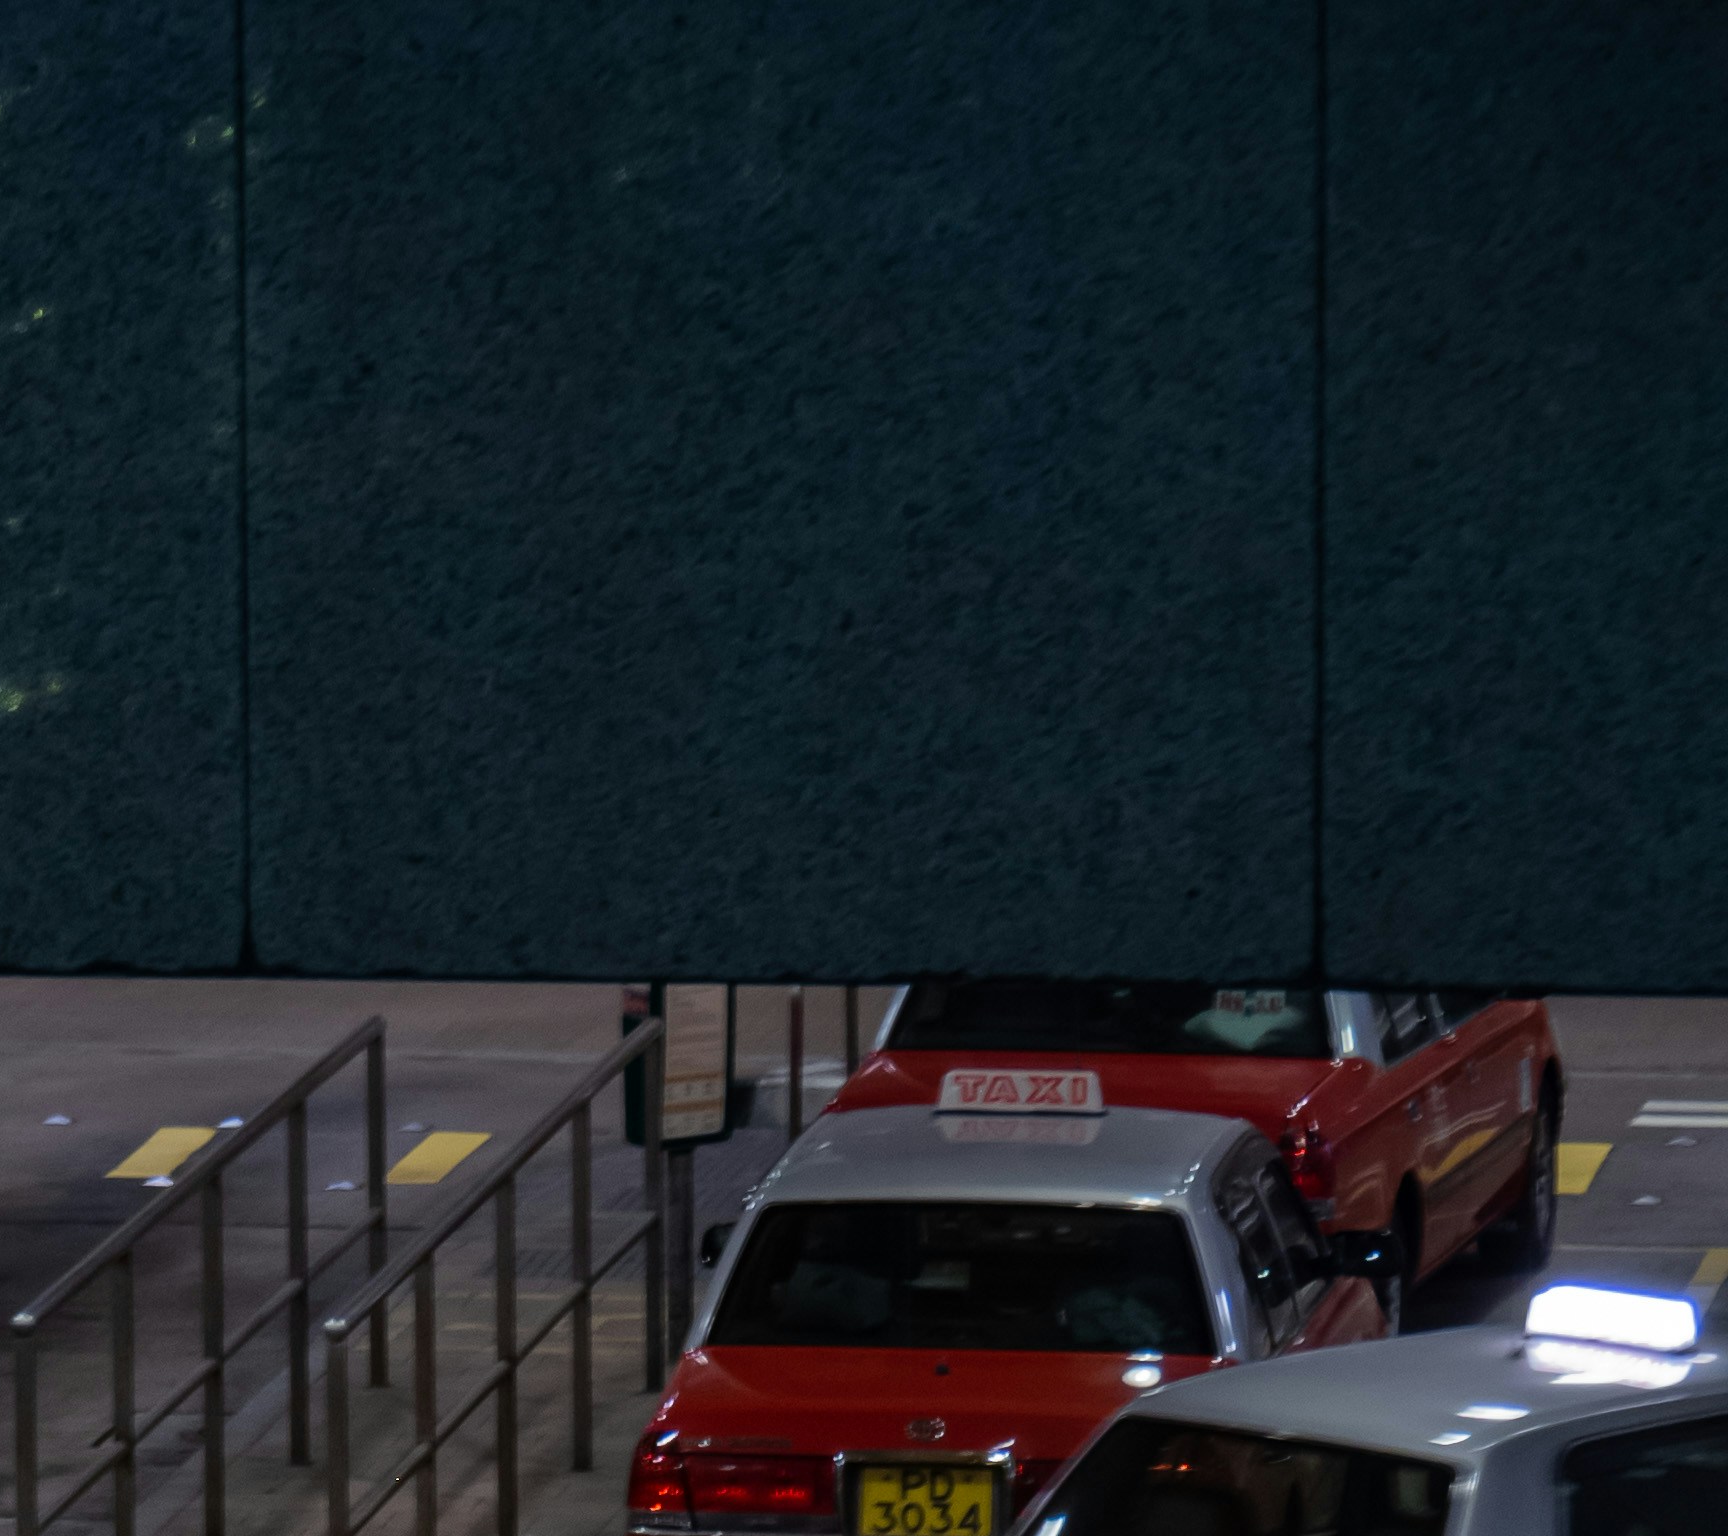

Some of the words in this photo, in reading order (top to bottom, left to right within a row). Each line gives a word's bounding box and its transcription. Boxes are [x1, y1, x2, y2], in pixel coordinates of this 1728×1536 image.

[954, 1075, 1088, 1105] TAXI
[899, 1468, 956, 1502] PD
[873, 1501, 983, 1534] 3034
